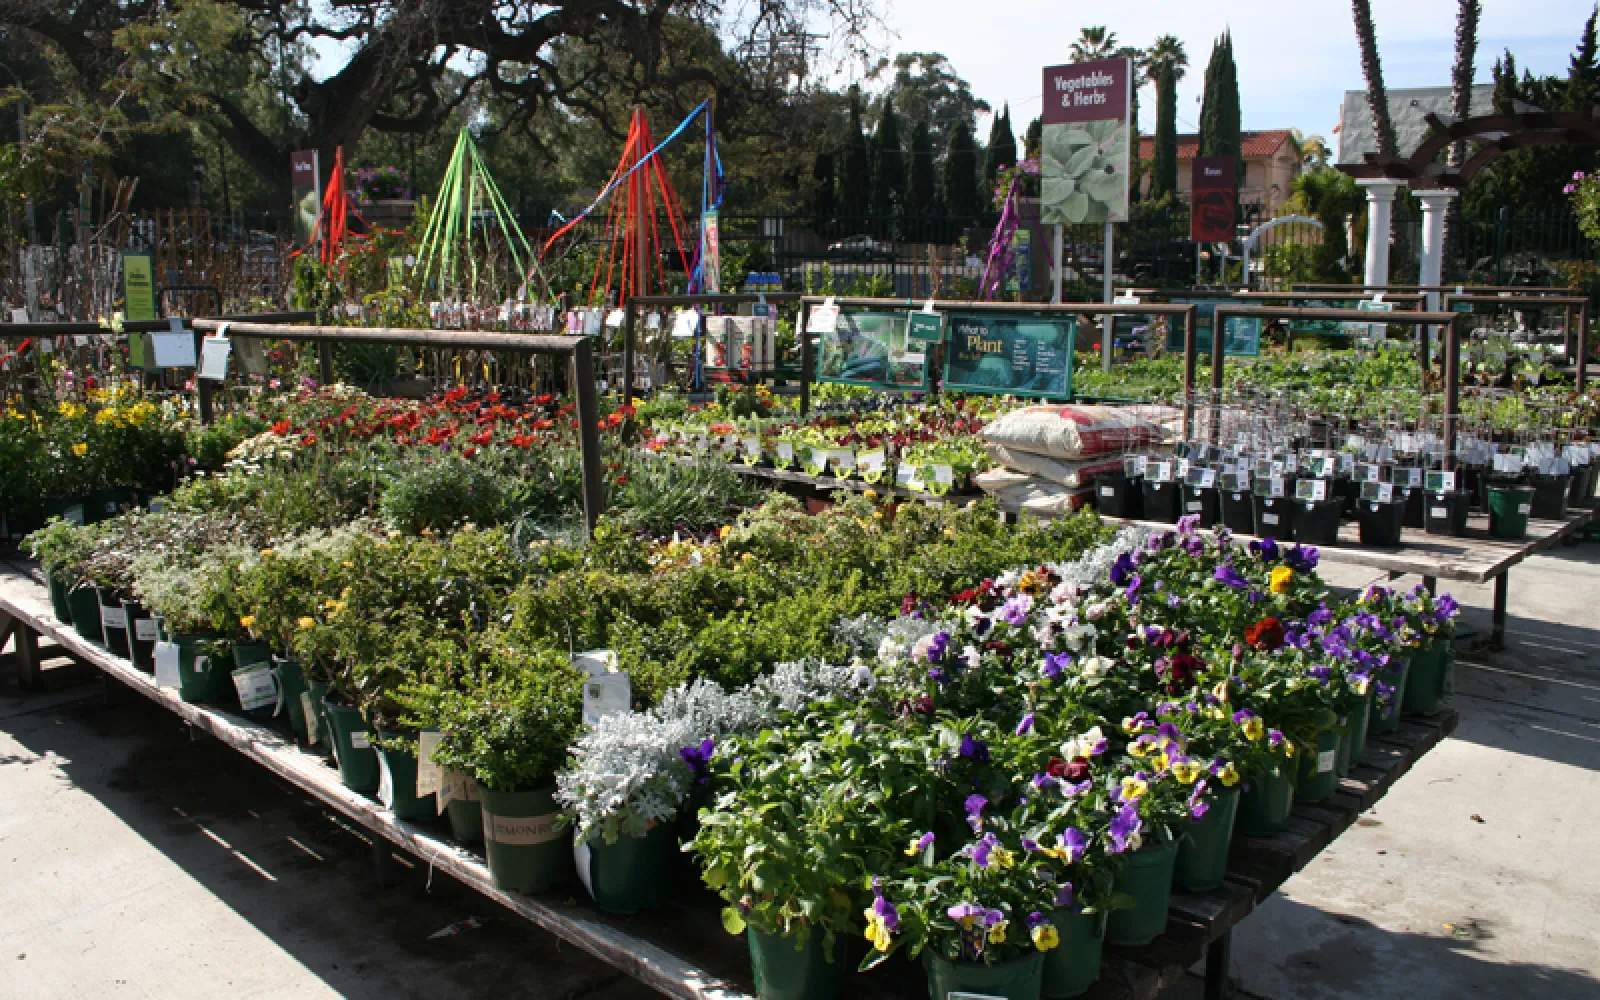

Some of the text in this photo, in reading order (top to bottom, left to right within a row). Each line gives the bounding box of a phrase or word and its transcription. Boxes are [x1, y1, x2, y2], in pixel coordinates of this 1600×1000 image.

[1053, 70, 1114, 93] Vegetables
[1061, 89, 1107, 108] & Herbs
[967, 335, 1003, 353] Plant
